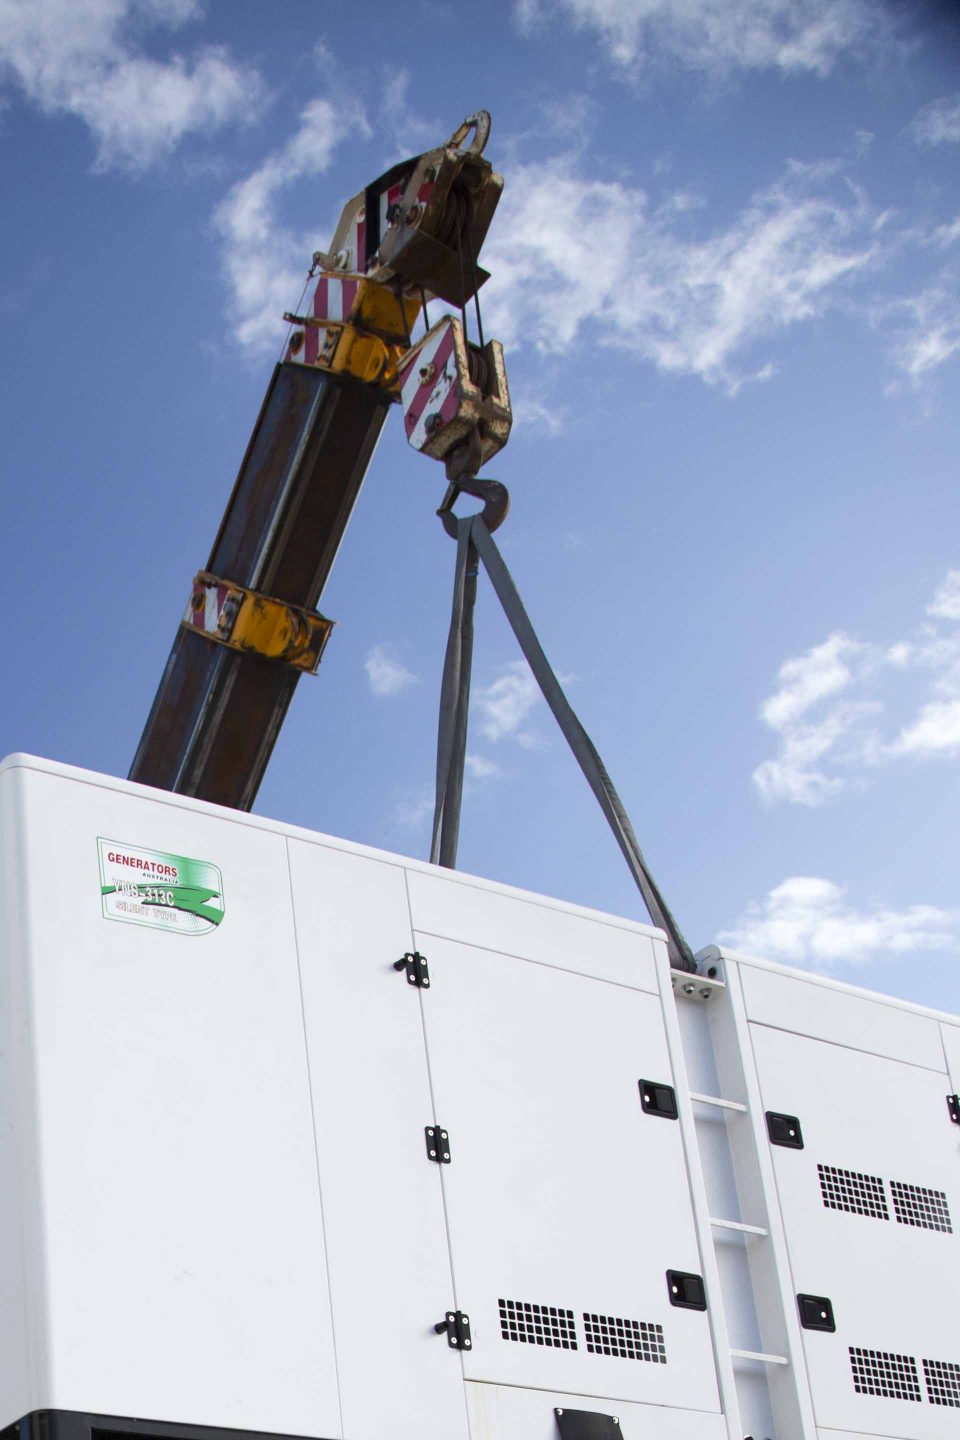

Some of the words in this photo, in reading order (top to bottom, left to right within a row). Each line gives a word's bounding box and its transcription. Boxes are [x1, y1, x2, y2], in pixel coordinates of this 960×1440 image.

[107, 852, 178, 877] GENERATORS
[142, 872, 179, 885] AUSTRALIA
[115, 900, 150, 917] SILENT
